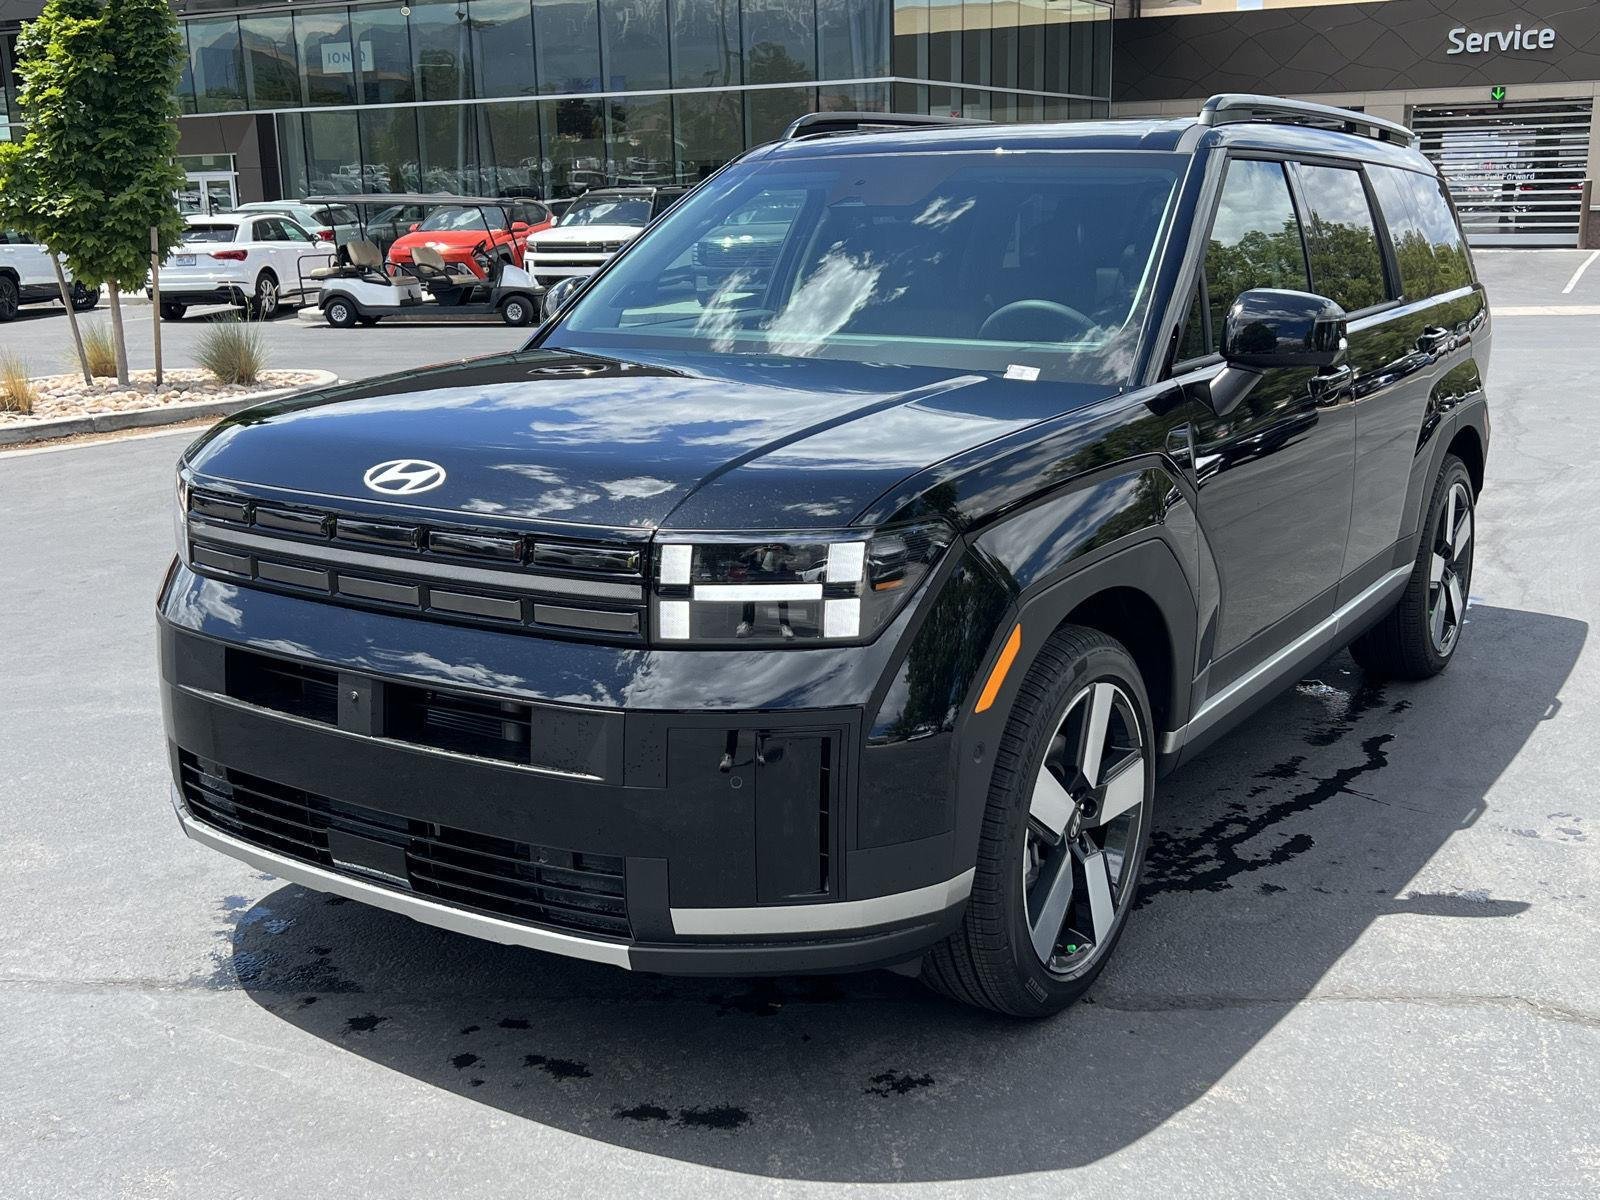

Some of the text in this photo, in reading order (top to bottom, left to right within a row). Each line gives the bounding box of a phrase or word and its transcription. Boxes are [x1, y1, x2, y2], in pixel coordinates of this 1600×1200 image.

[1446, 24, 1556, 54] Service
[327, 51, 366, 64] IONQ
[1501, 172, 1535, 180] Forward
